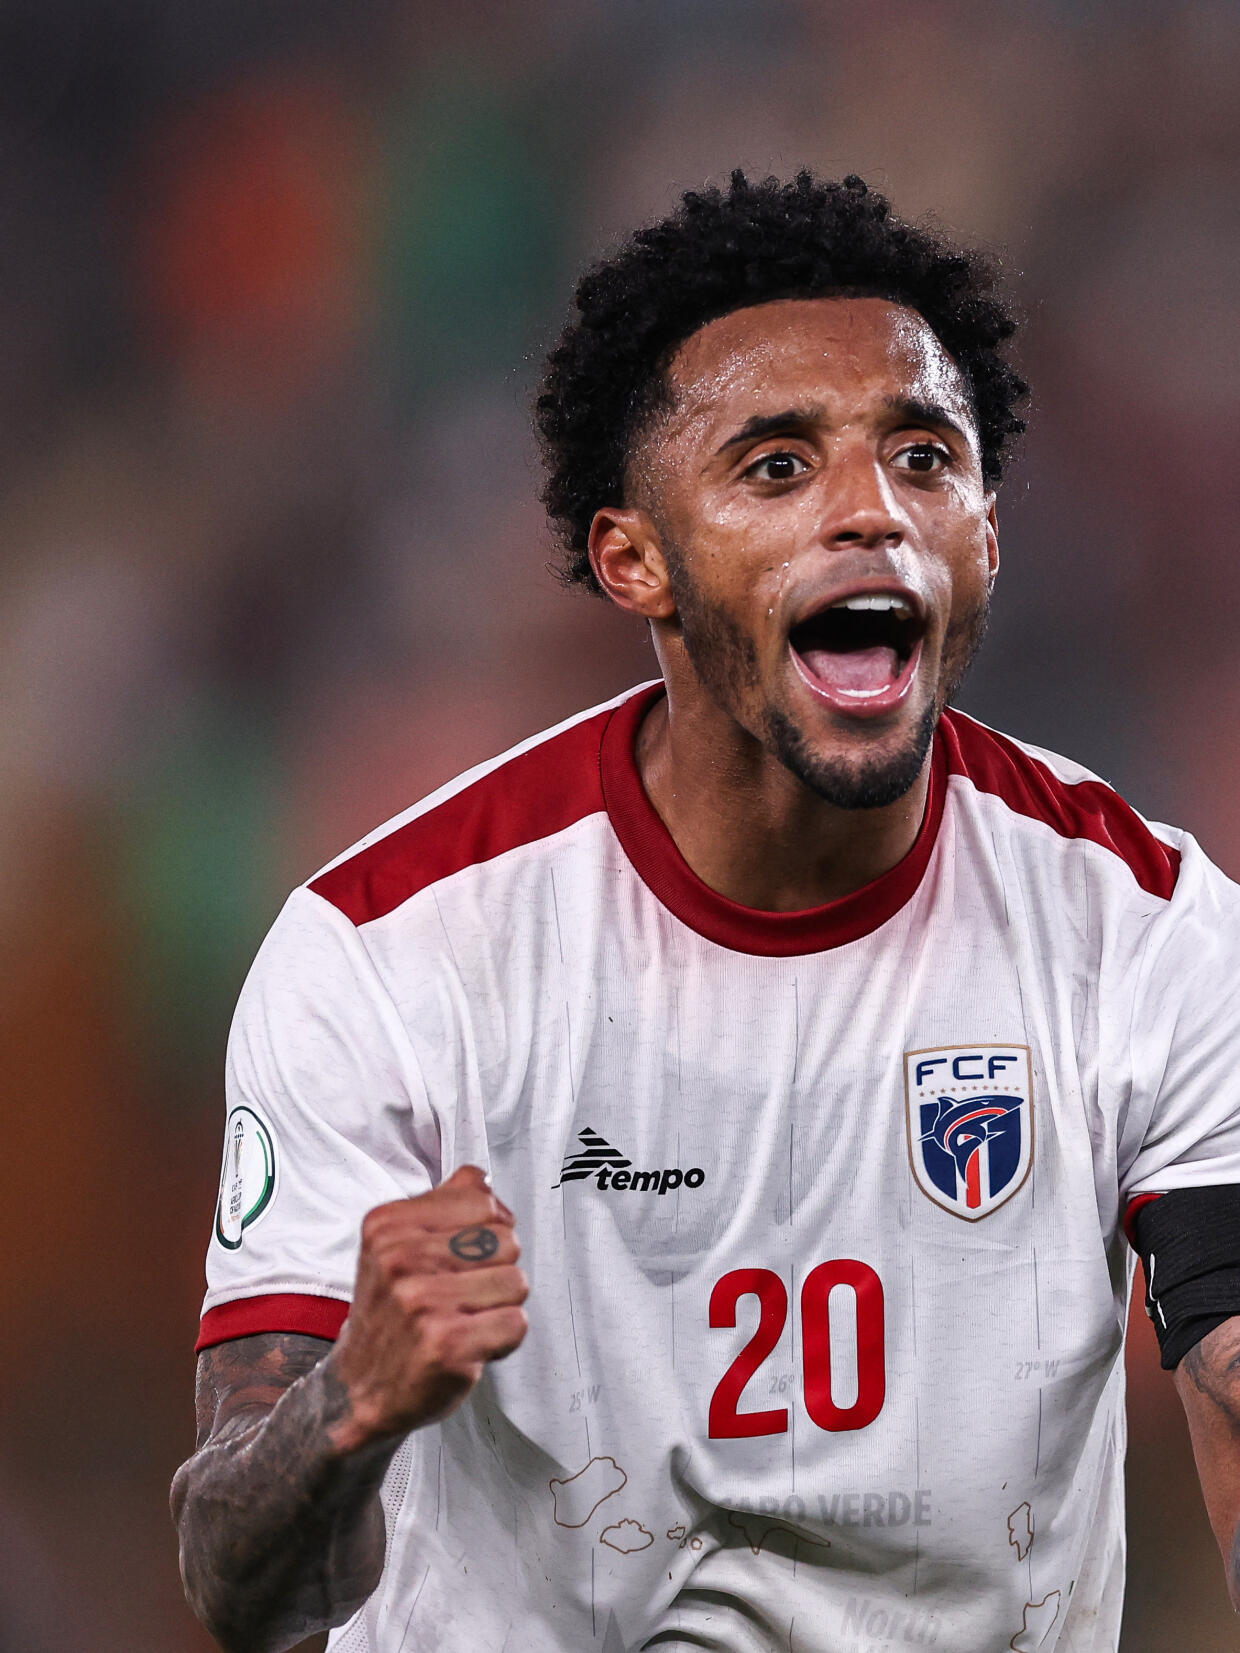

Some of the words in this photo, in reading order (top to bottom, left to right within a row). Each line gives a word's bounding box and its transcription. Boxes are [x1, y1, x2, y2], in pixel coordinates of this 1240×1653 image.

[916, 1055, 1018, 1086] FCF
[594, 1167, 706, 1195] tempo
[708, 1258, 886, 1439] 20
[817, 1488, 932, 1528] VERDE
